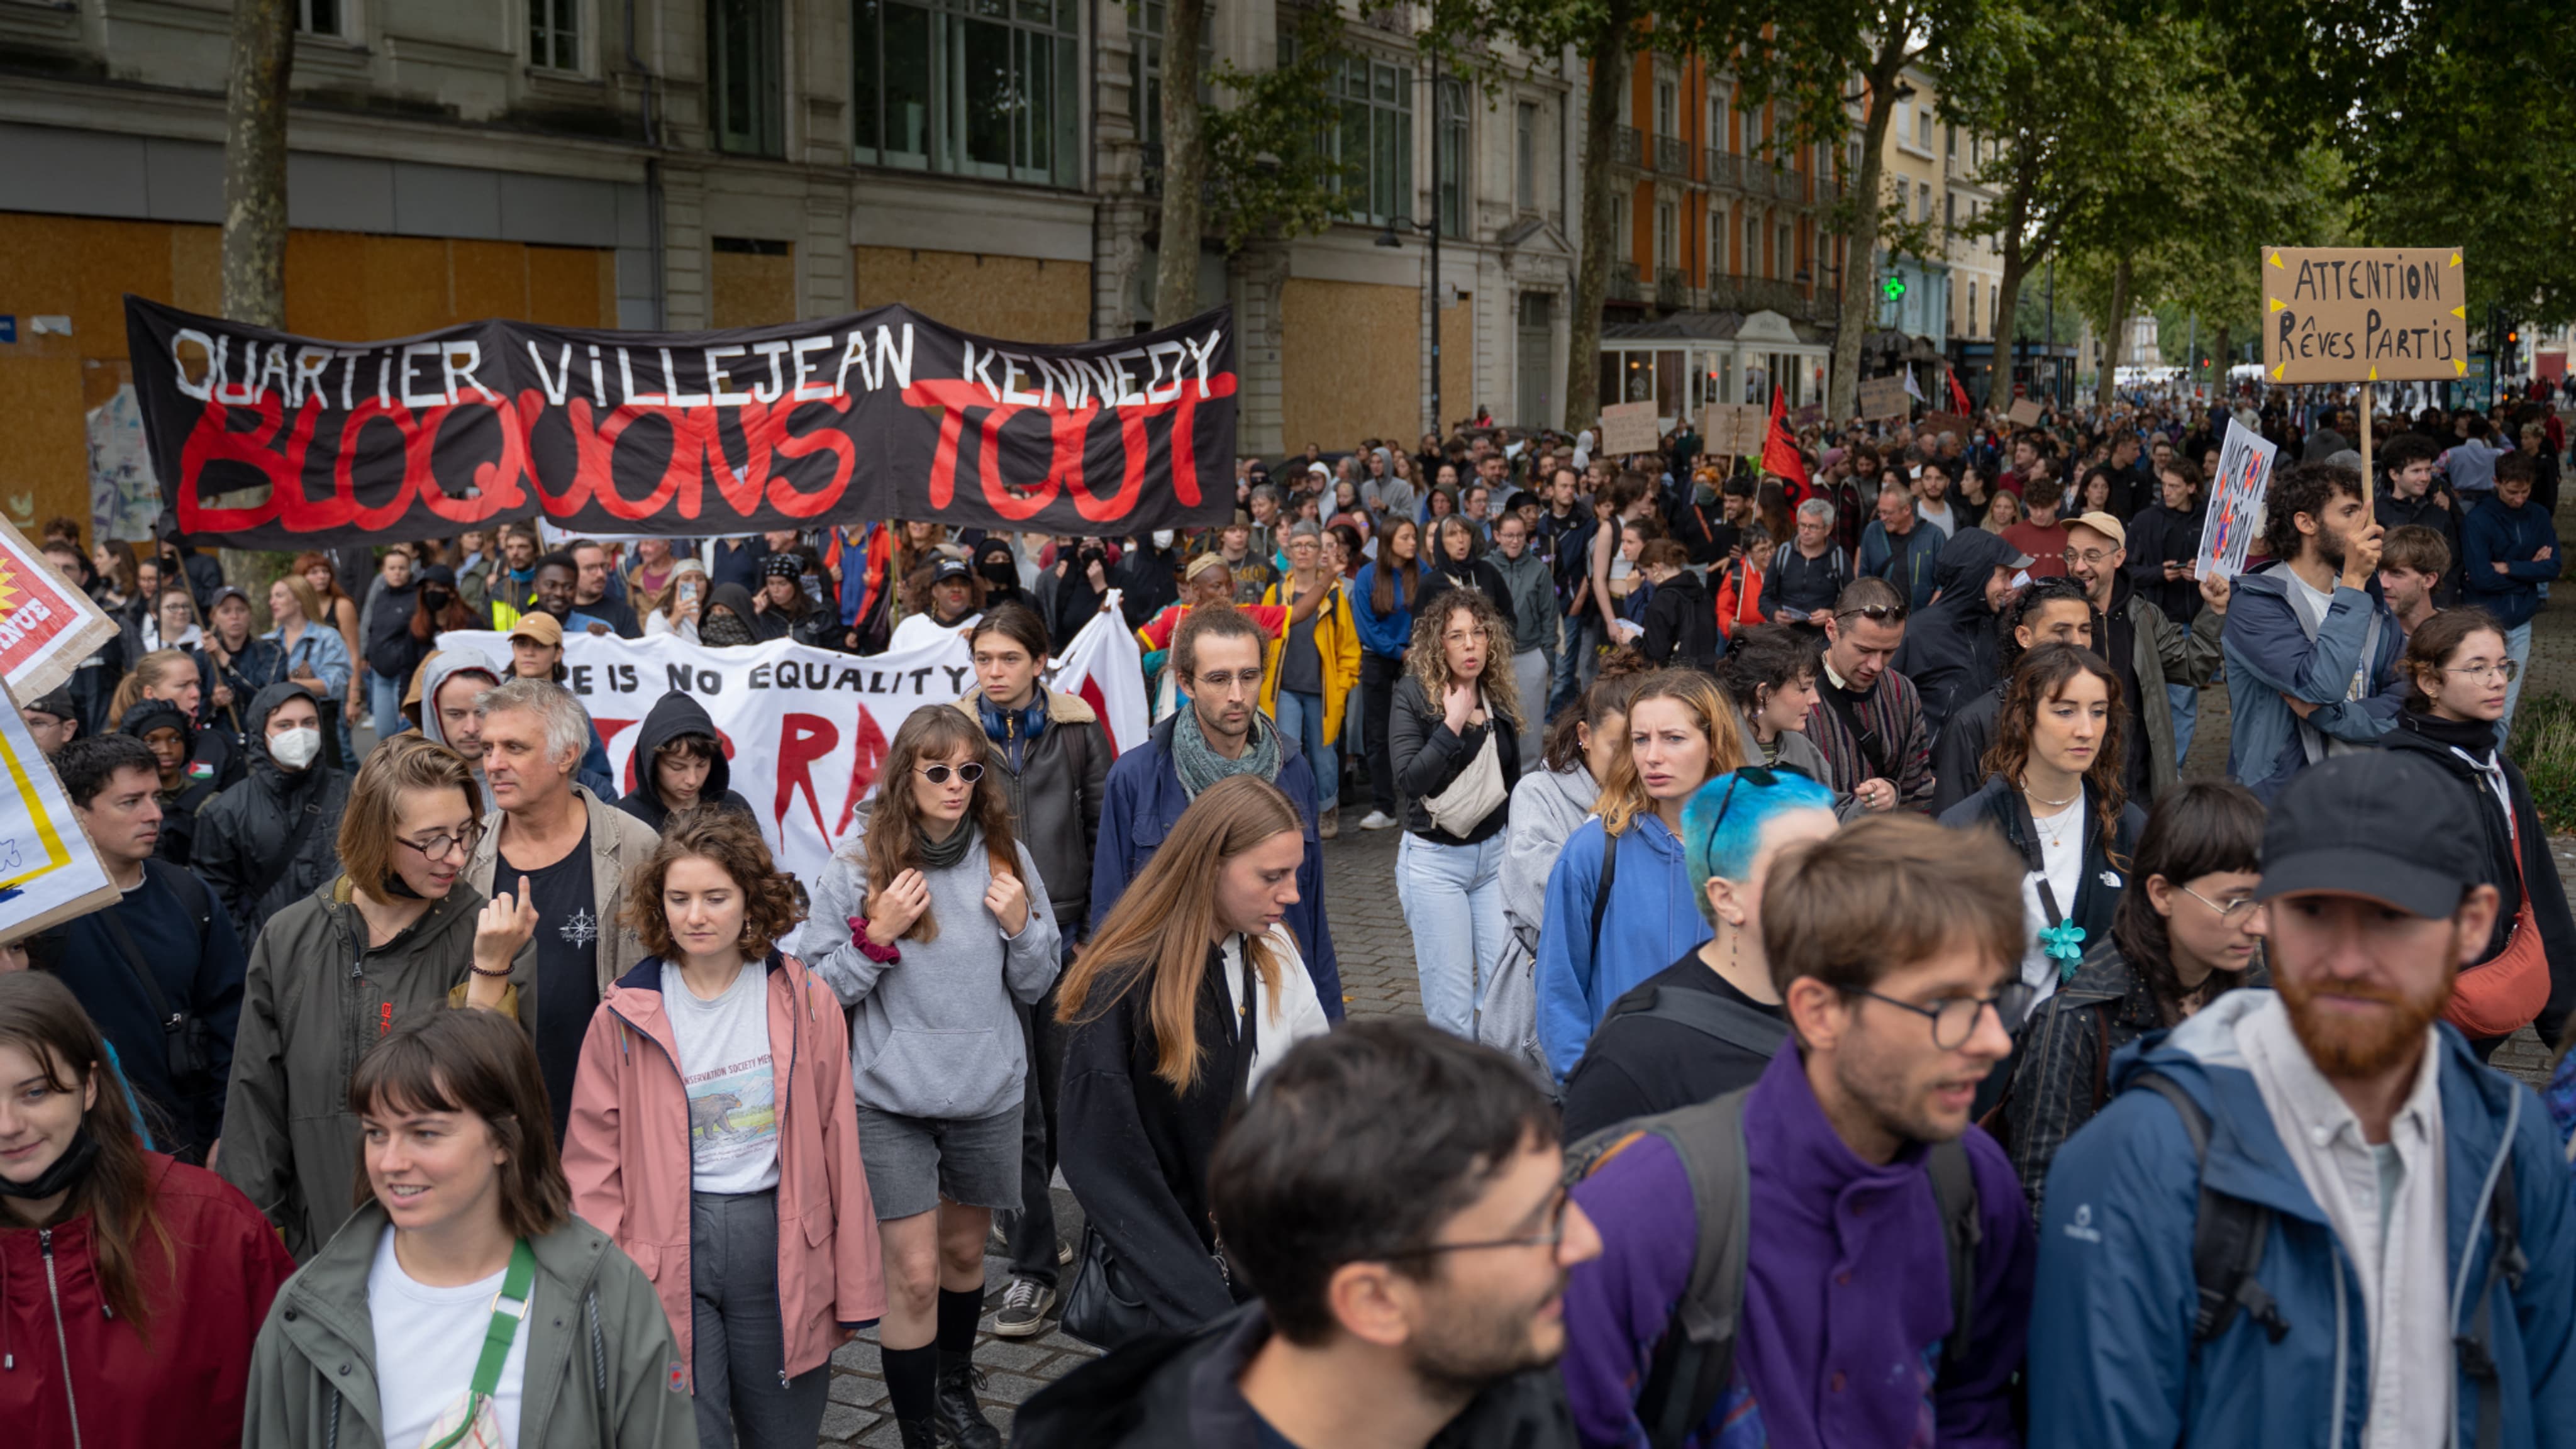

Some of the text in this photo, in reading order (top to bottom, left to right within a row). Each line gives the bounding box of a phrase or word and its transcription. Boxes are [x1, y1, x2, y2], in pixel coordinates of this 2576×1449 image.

[963, 329, 1221, 409] KENNEDY
[178, 372, 1238, 536] BLOQUONS TOUT
[607, 663, 639, 694] IS
[666, 663, 722, 696] NO
[748, 660, 969, 695] EQUALITY
[728, 1058, 756, 1074] SOCIETY
